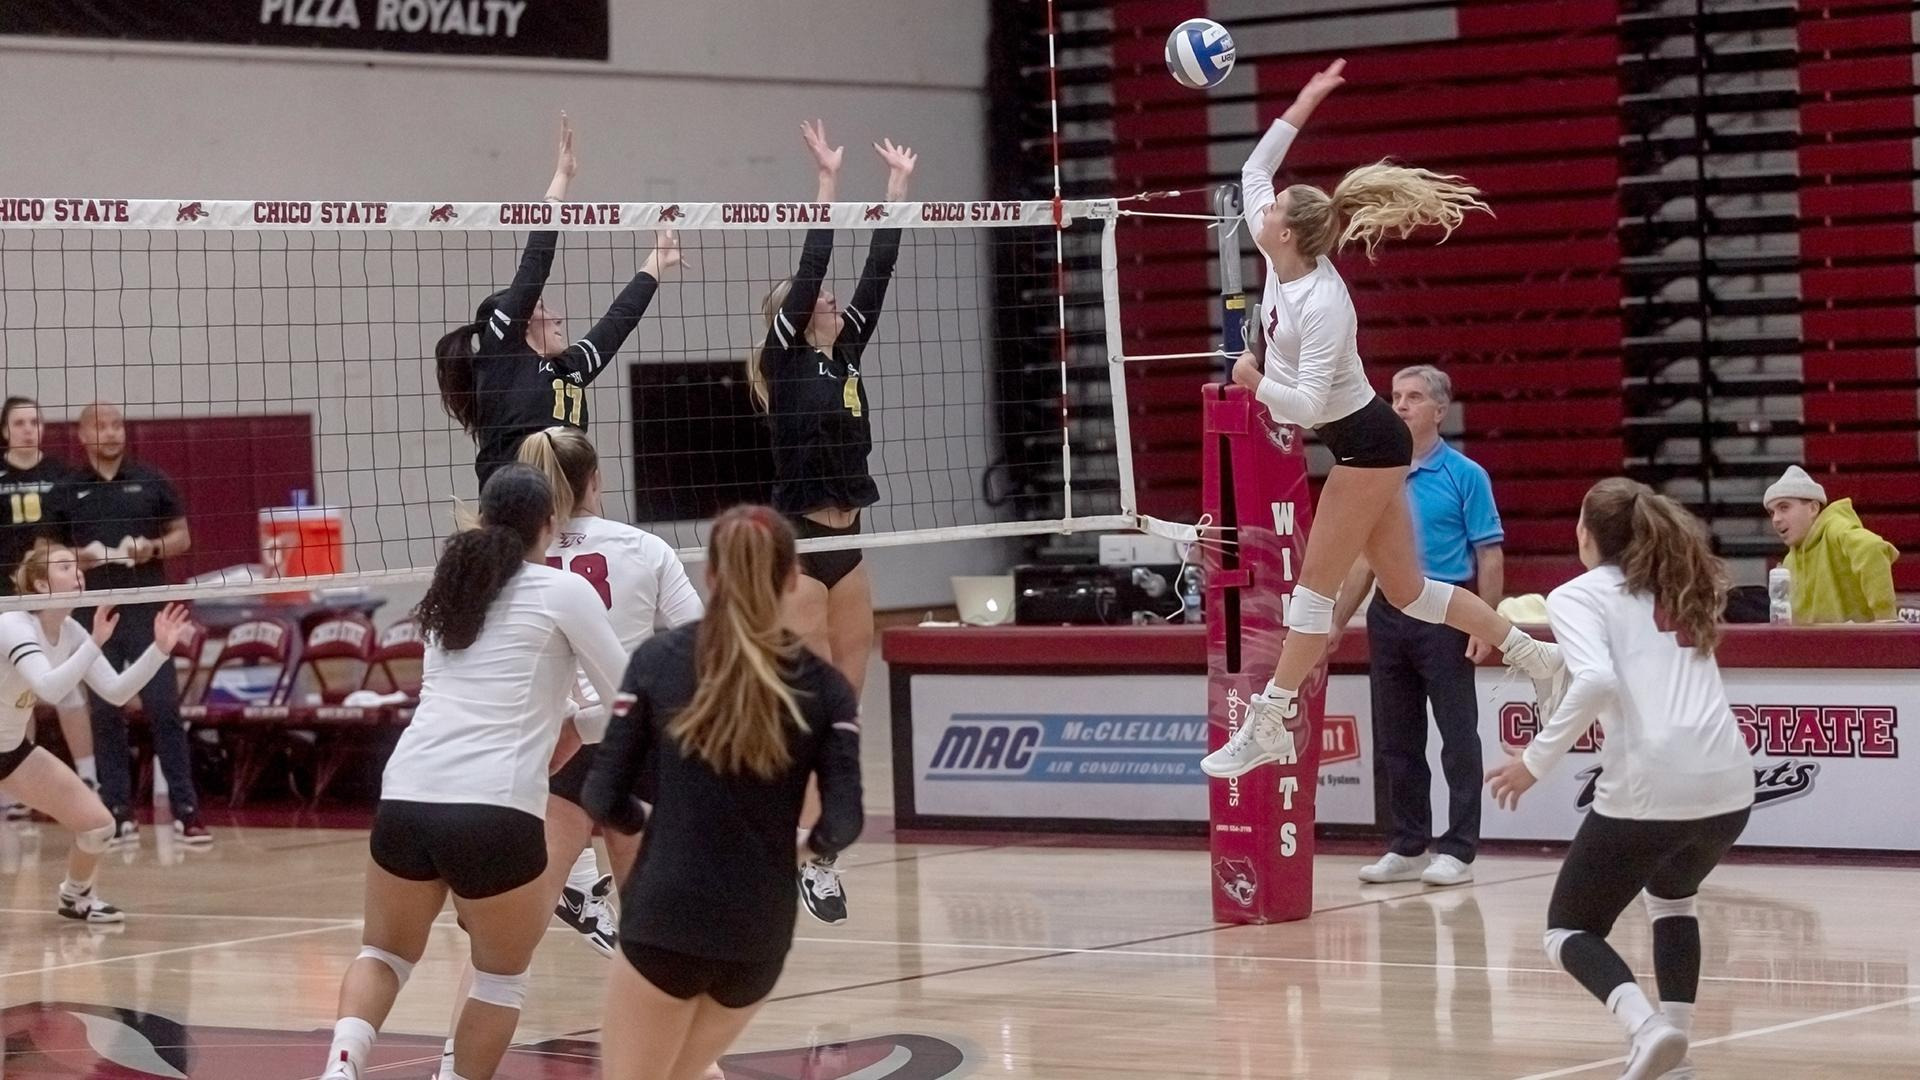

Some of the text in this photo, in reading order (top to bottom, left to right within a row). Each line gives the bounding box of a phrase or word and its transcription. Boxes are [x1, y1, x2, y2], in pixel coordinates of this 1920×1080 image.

[260, 0, 527, 37] PIZZA ROYALTY
[54, 200, 129, 222] STATE
[254, 201, 388, 223] CHICO STATE
[500, 203, 620, 224] CHICO STATE
[722, 203, 831, 223] CHICO STATE
[922, 202, 1021, 222] CHICO STATE
[552, 378, 583, 426] 17
[11, 492, 42, 523] 10
[545, 552, 612, 611] 8
[1729, 704, 1898, 758] STATE
[929, 726, 1040, 770] MAC
[1045, 761, 1071, 774] AIR
[1078, 761, 1186, 775] CONDITIONING
